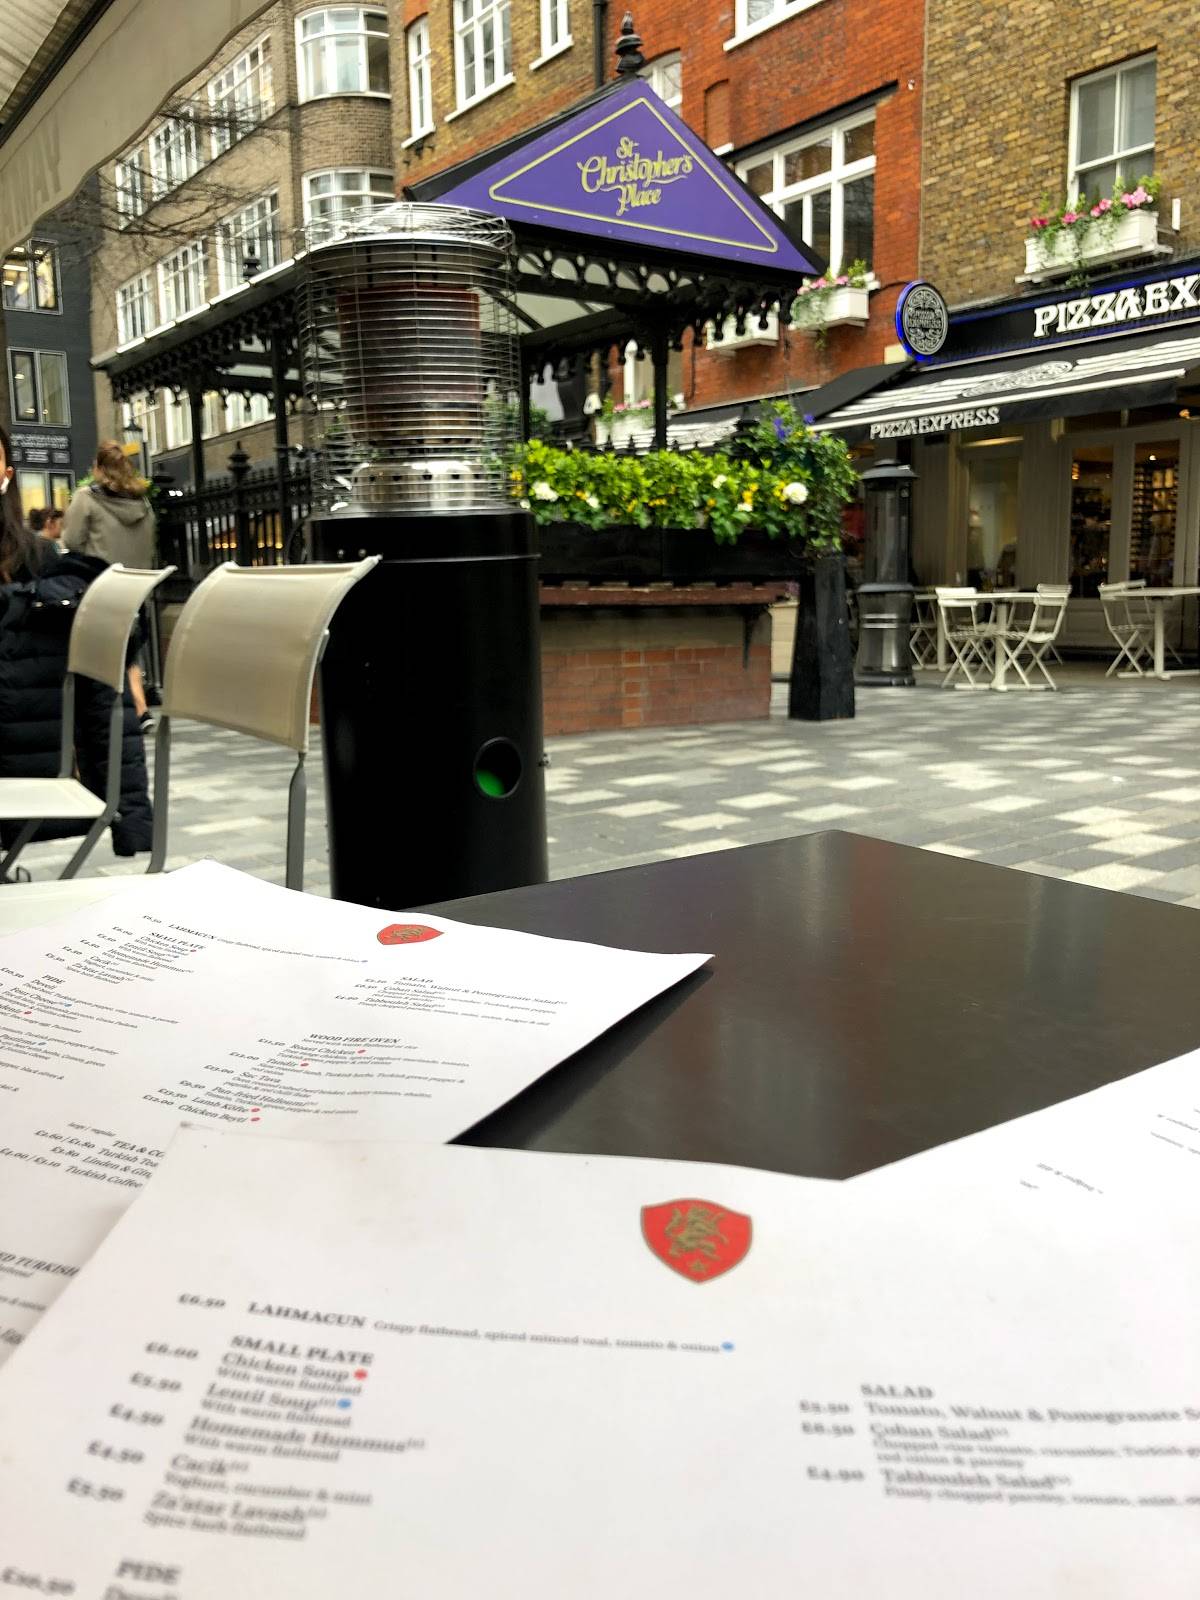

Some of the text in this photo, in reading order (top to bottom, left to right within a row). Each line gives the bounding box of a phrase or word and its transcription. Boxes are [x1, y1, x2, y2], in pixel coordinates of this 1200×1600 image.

[577, 150, 693, 193] Christopher's
[615, 184, 662, 216] Place
[168, 924, 217, 940] LAHMACUN
[42, 974, 66, 985] PIDE
[290, 1044, 318, 1052] Roast
[318, 1047, 356, 1055] Chicken
[310, 1033, 402, 1045] WOOD FIRE OVEN
[192, 1096, 223, 1109] Lamb
[211, 1086, 258, 1100] Pan-fried
[177, 1104, 219, 1120] Chicken
[218, 1112, 249, 1125] Beyti
[112, 1140, 138, 1152] TEA
[81, 1155, 119, 1171] Linden
[119, 1164, 132, 1174] &
[97, 1148, 140, 1164] Turkish
[139, 1157, 160, 1169] Tea
[63, 1165, 108, 1181] Turkish
[106, 1174, 144, 1190] Coffee
[16, 1256, 81, 1277] TURKISH
[248, 1301, 367, 1328] LAHMACUN
[229, 1334, 376, 1366] SMALL PLATE
[221, 1350, 299, 1377] Chicken
[301, 1364, 351, 1383] Soup
[206, 1381, 267, 1405] Lentil
[860, 1383, 936, 1399] SALAD
[949, 1404, 1022, 1423] Walnut
[1047, 1406, 1182, 1426] Pomegranate
[188, 1414, 307, 1445] Homemade
[116, 1556, 184, 1588] PIDE
